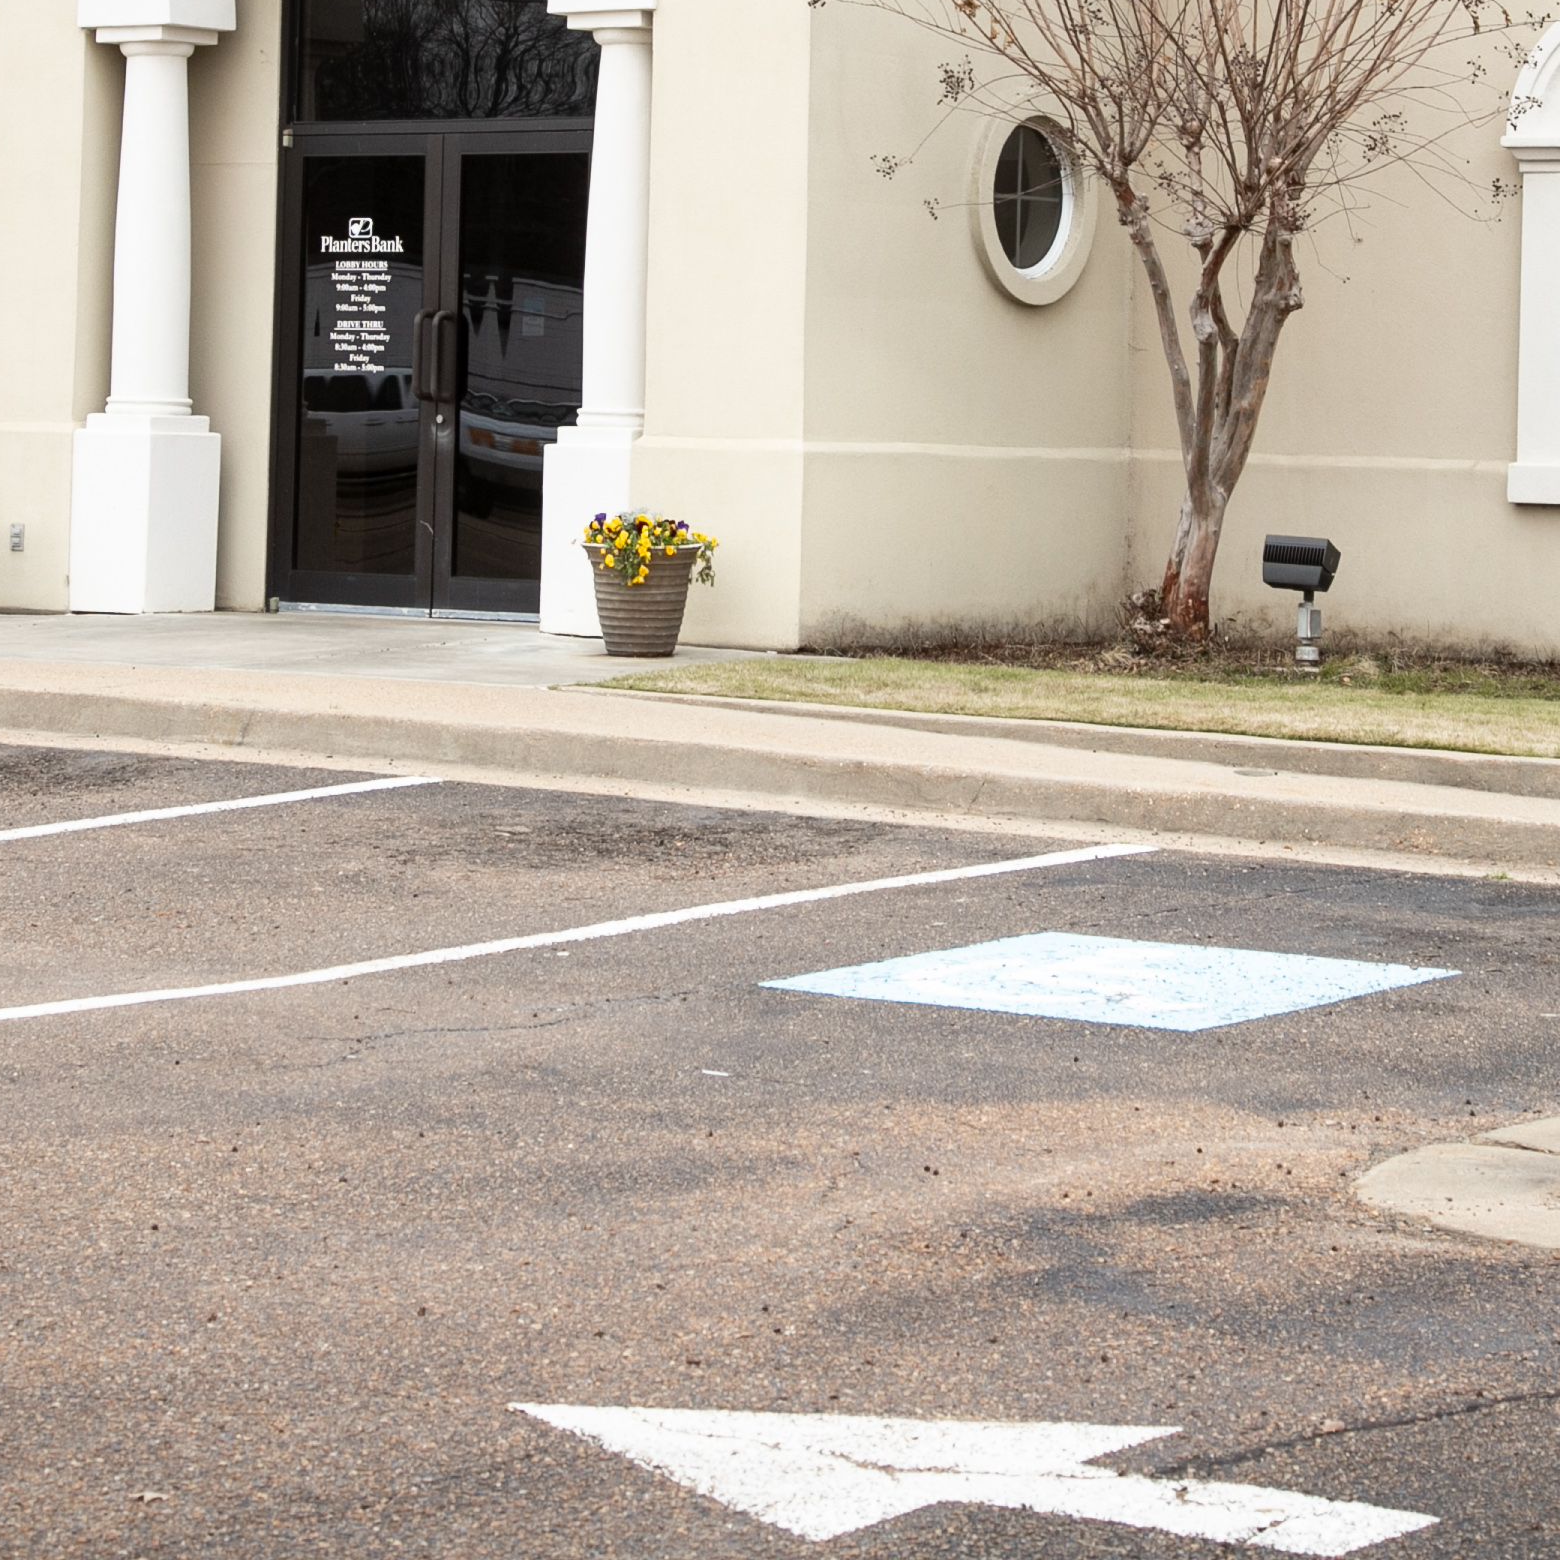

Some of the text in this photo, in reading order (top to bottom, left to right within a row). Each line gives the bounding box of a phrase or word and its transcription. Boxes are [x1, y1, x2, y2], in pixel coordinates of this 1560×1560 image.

[335, 261, 388, 269] LOBBY HOURS
[331, 273, 357, 282] Monday
[362, 273, 392, 282] Thursday
[351, 294, 371, 303] Friday
[330, 332, 355, 342] Monday
[360, 332, 390, 342] Thursday
[349, 354, 370, 363] Friday
